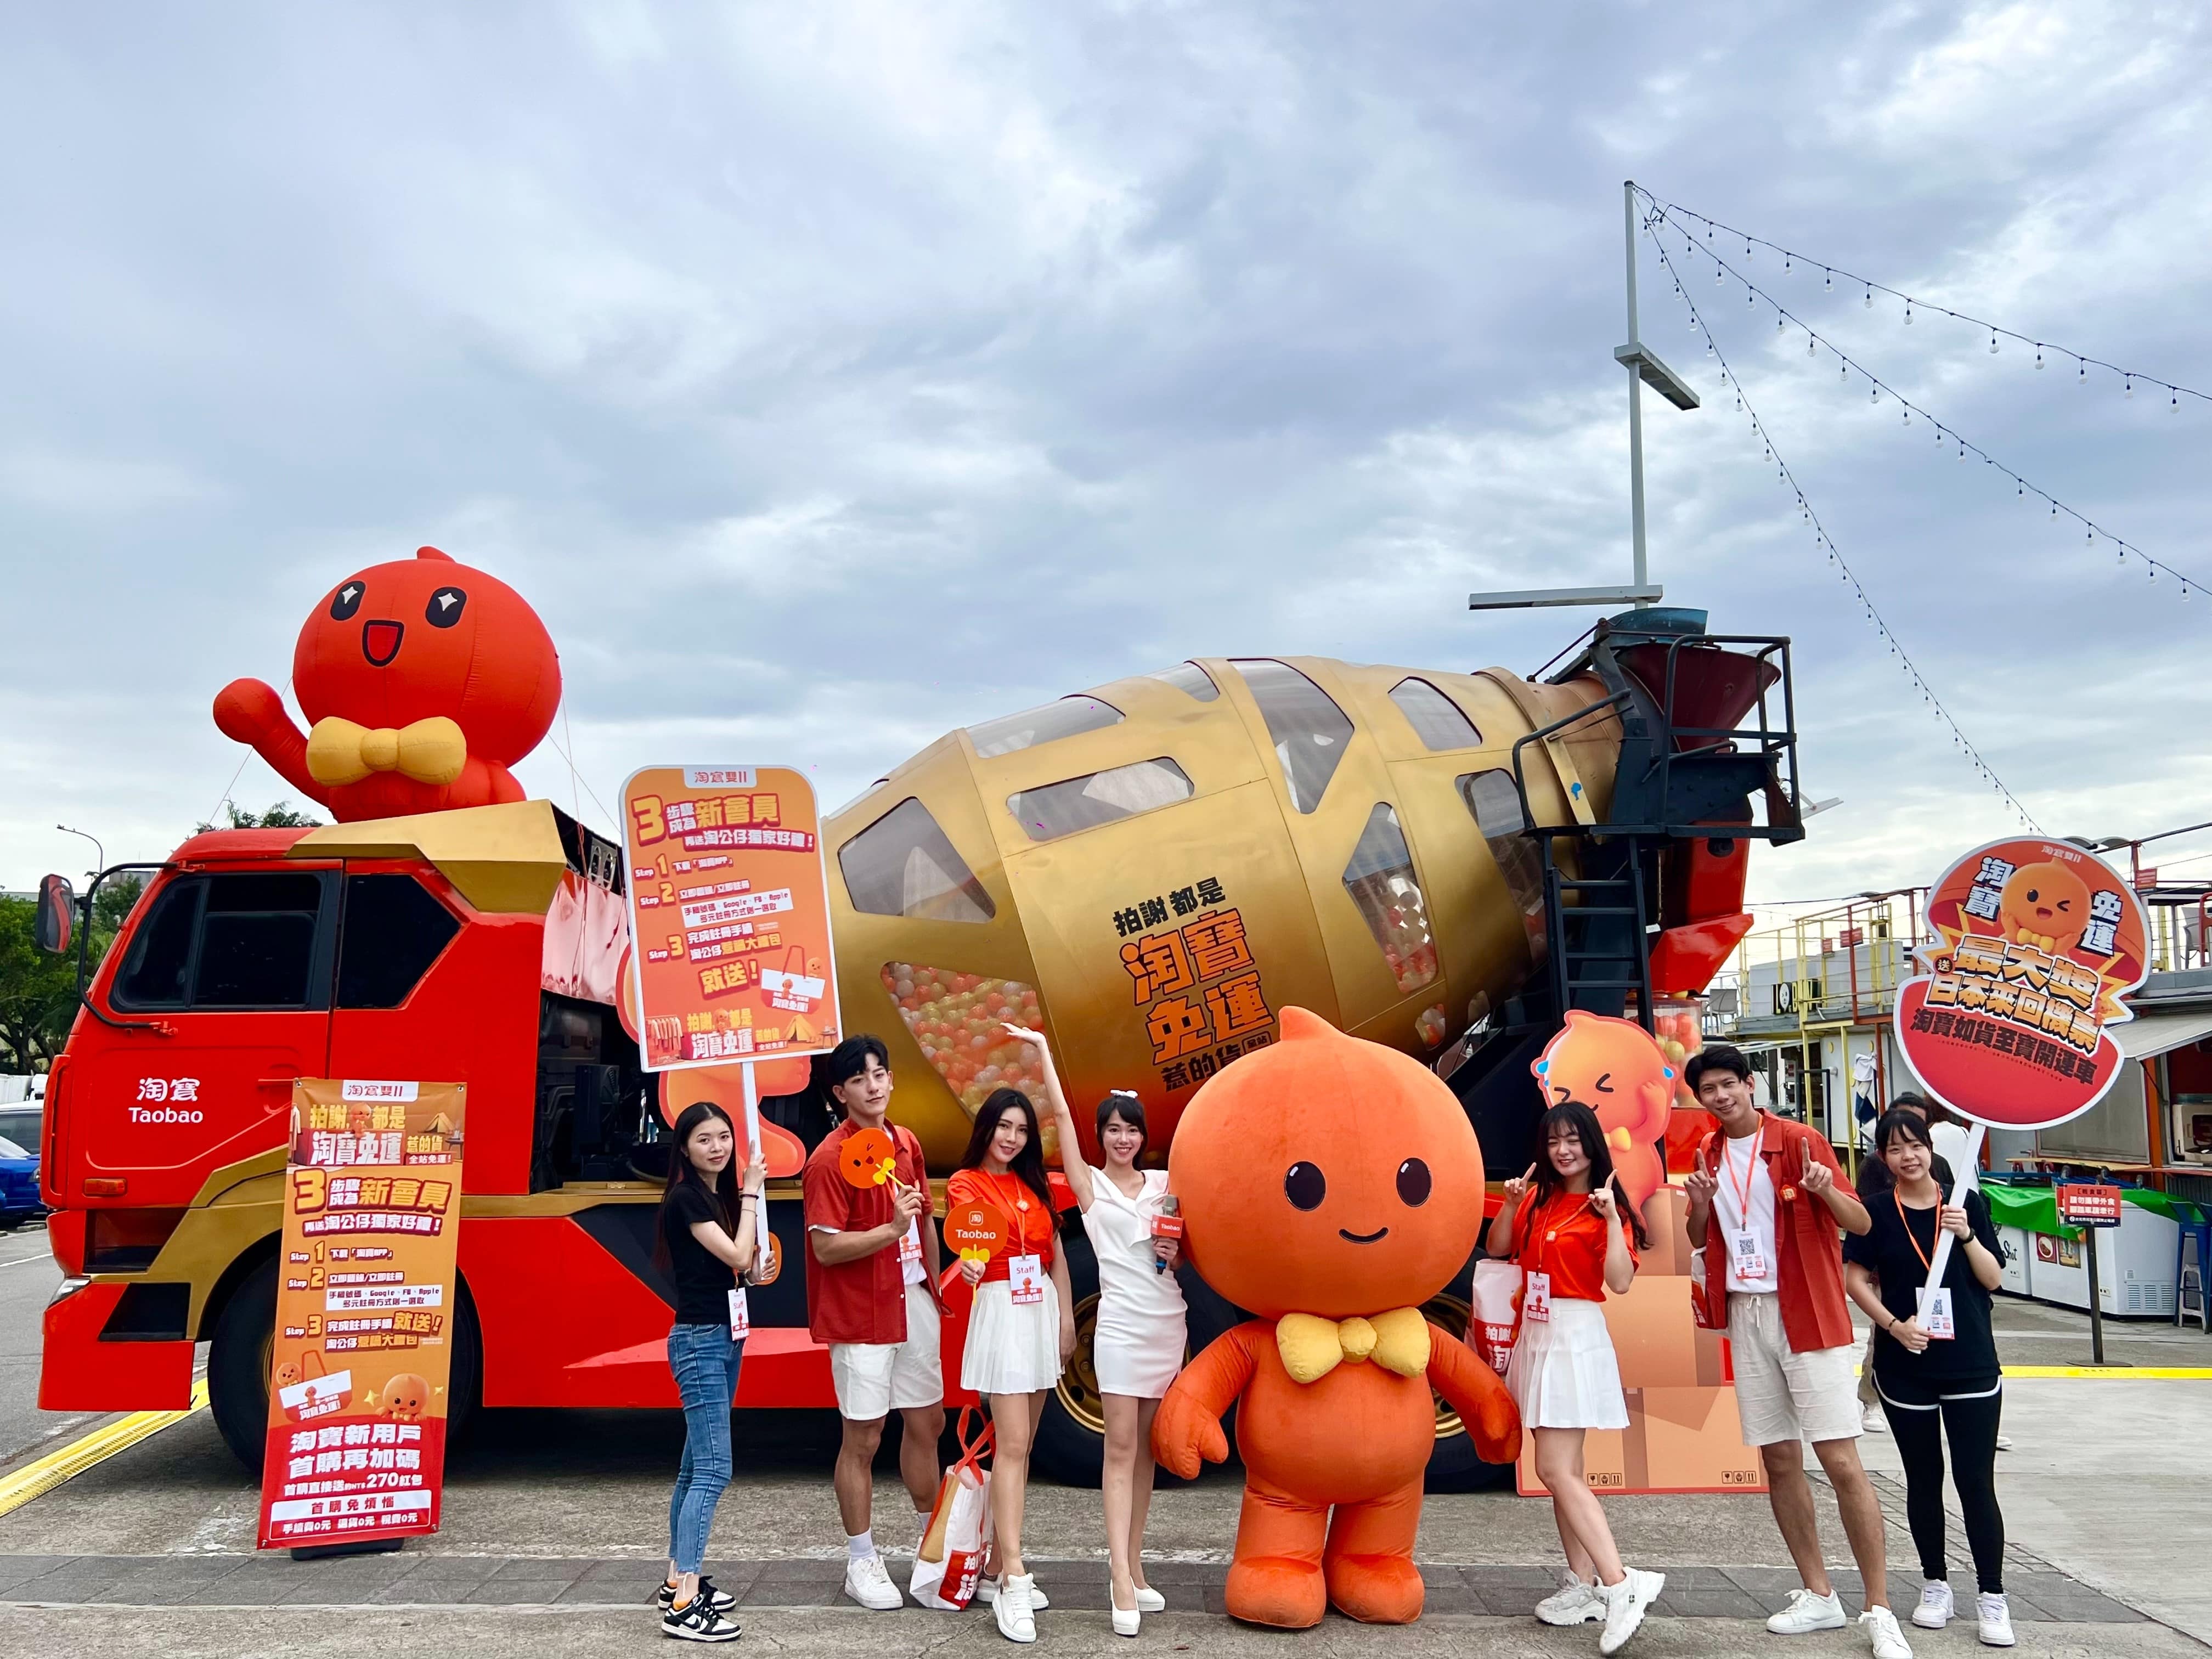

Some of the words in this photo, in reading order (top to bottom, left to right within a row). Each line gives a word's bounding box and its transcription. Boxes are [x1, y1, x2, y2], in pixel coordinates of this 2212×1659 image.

[632, 795, 665, 842] 3
[695, 795, 778, 828] 新會員
[635, 868, 654, 878] Step
[657, 854, 668, 874] 1
[640, 896, 659, 906] Step
[660, 883, 675, 903] 2
[1965, 856, 2016, 921] 淘寶
[1113, 895, 1169, 938] 拍謝
[1169, 877, 1226, 917] 都是
[2078, 890, 2123, 956] 免運
[649, 950, 668, 960] Step
[668, 935, 684, 957] 3
[1119, 907, 1255, 1007] 淘寶
[1937, 958, 1951, 973] 送
[1955, 935, 2099, 1011] 最大獎
[1146, 969, 1276, 1065] 免運
[1926, 974, 2103, 1053] 日本來回機票
[137, 1077, 200, 1102] 淘寶
[128, 1107, 204, 1123] Taobao
[372, 1105, 406, 1130] 都是
[310, 1131, 403, 1165] 淘寶免運
[294, 1169, 325, 1210] 3
[359, 1178, 452, 1210] 新會員
[956, 1229, 996, 1239] Taobao
[290, 1252, 310, 1261] Step
[315, 1241, 325, 1261] 1
[288, 1279, 308, 1288] Step
[311, 1267, 324, 1288] 2
[1016, 1265, 1035, 1274] Staff
[1532, 1283, 1545, 1291] Staff
[285, 1327, 305, 1336] Step
[308, 1315, 322, 1335] 3
[289, 1424, 422, 1453] 淘寶新用戶
[289, 1448, 421, 1480] 首購再加碼
